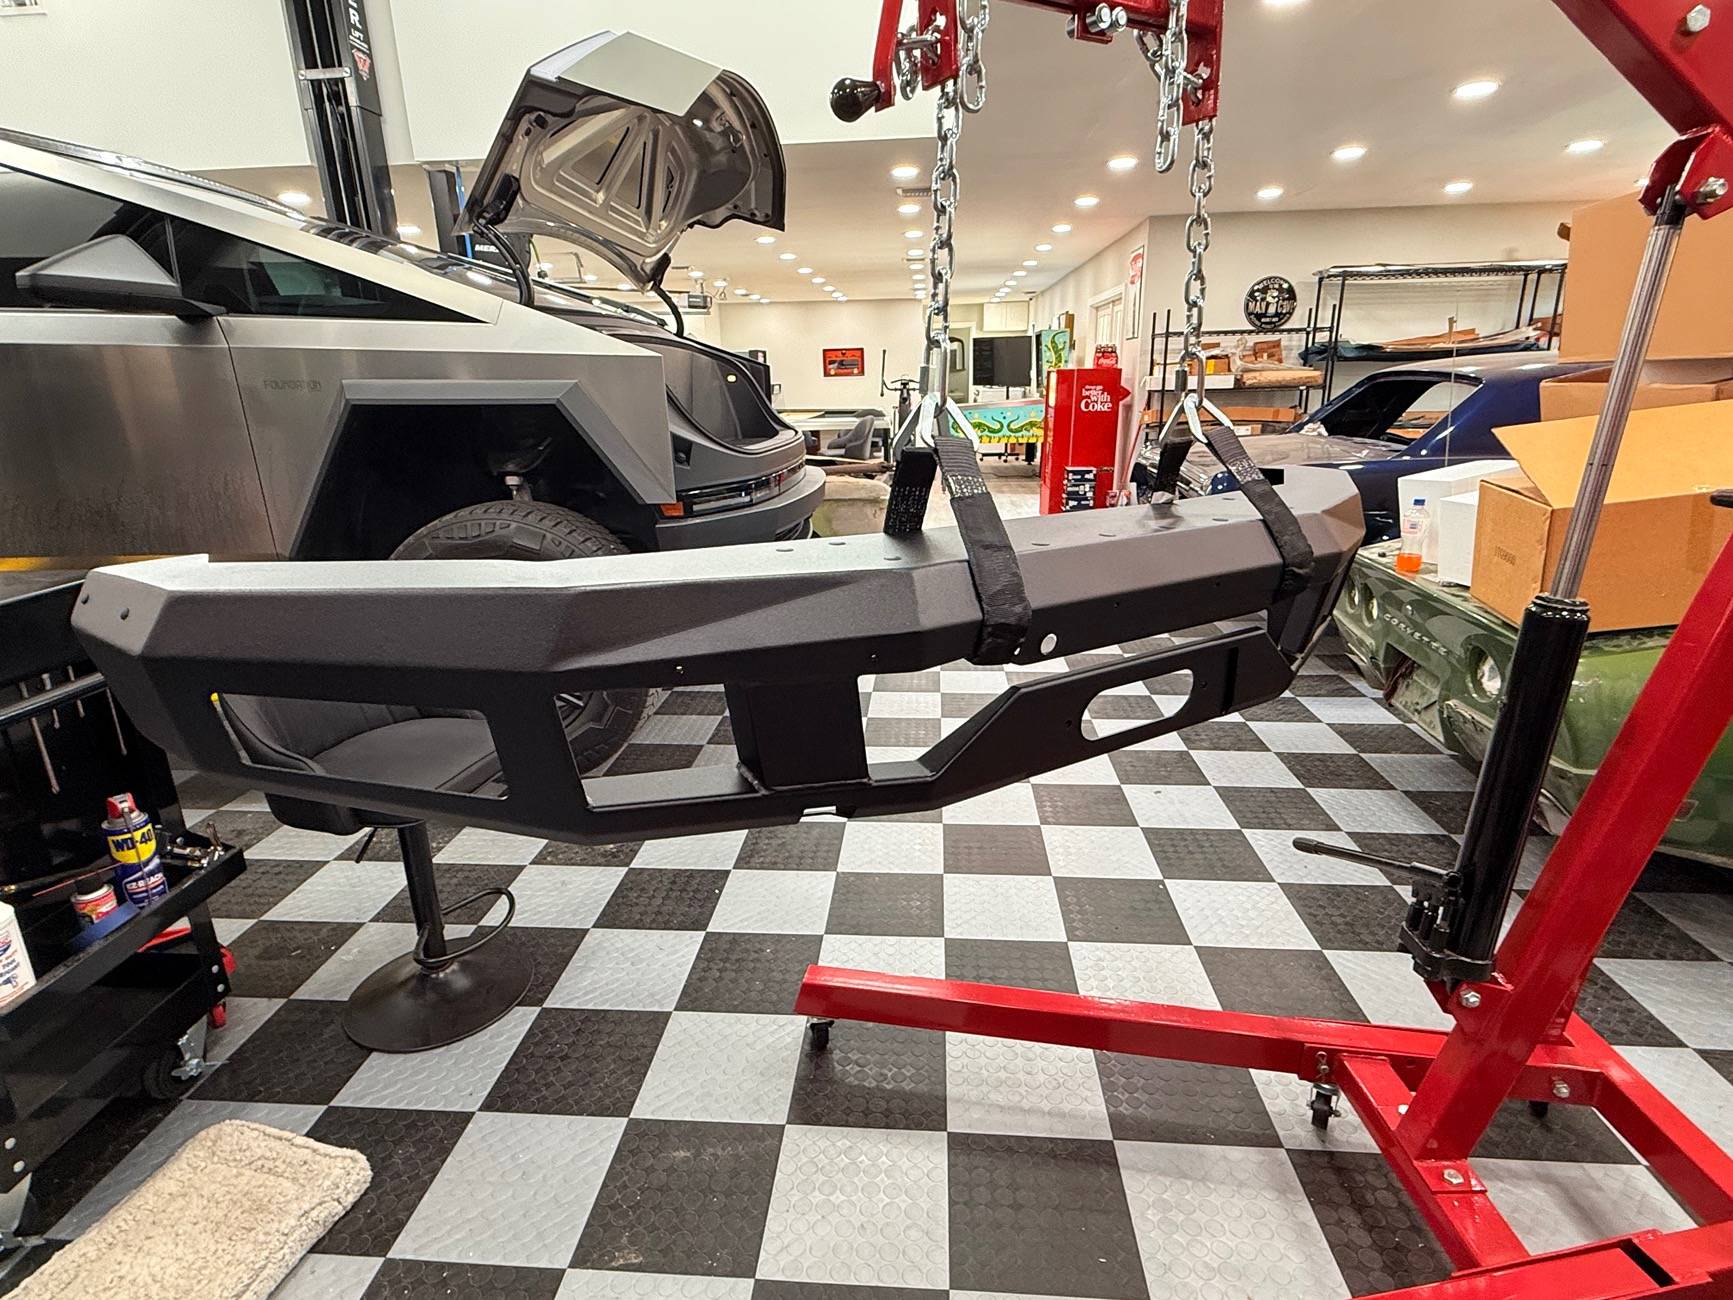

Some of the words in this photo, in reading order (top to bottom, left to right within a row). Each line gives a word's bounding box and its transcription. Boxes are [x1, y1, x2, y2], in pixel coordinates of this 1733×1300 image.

[1090, 391, 1111, 402] with
[1080, 398, 1113, 412] Coke
[111, 828, 153, 852] WD-40
